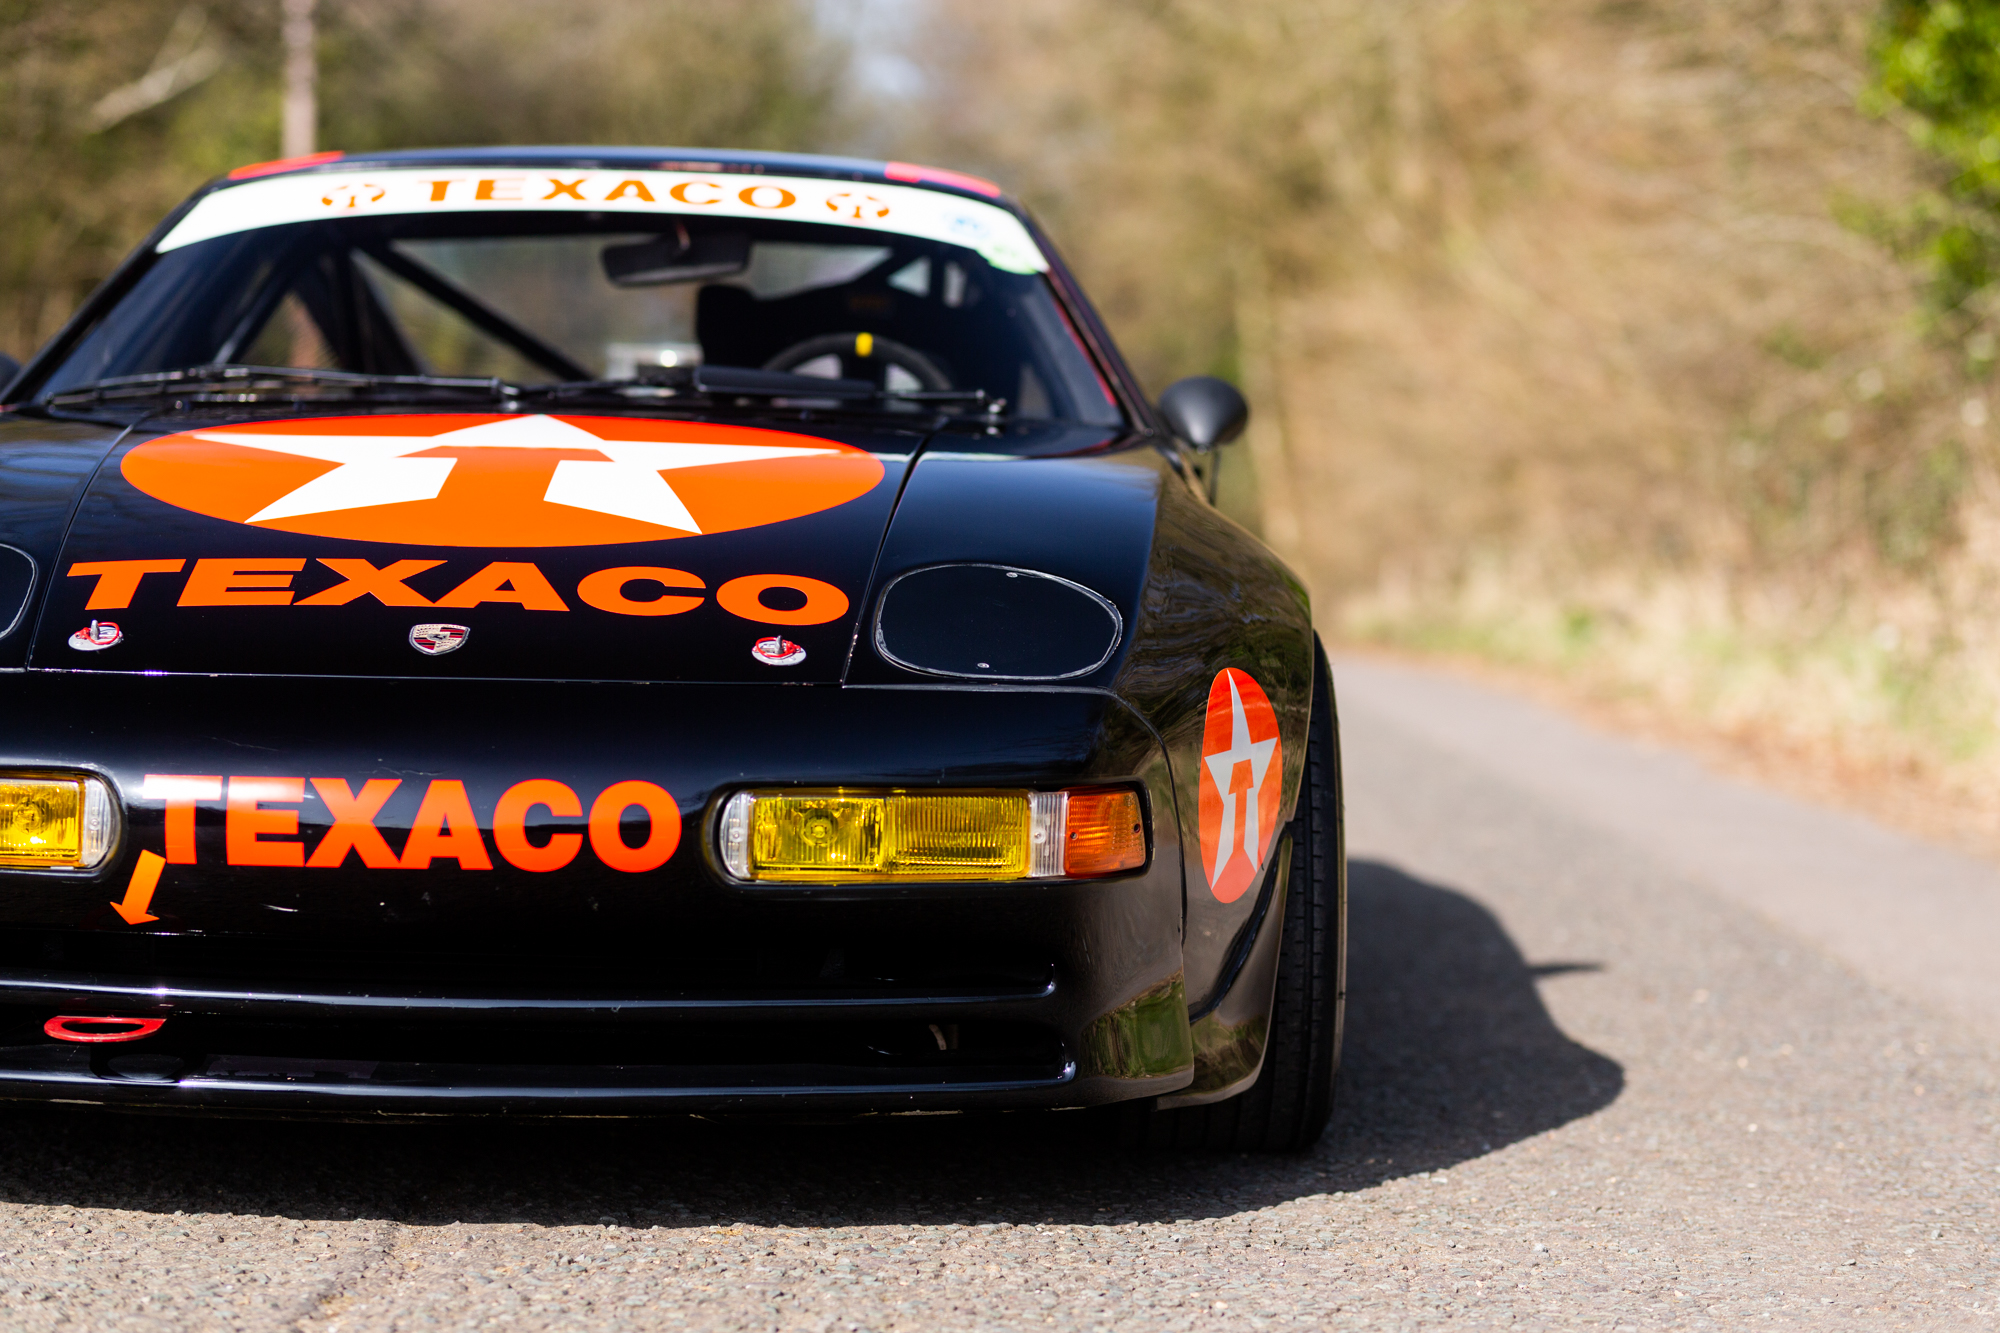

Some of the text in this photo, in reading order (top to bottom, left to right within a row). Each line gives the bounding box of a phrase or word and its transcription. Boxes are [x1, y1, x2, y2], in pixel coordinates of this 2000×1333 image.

[418, 178, 797, 210] TEXACO
[67, 557, 850, 626] TEXACO
[142, 774, 683, 874] TEXACO
